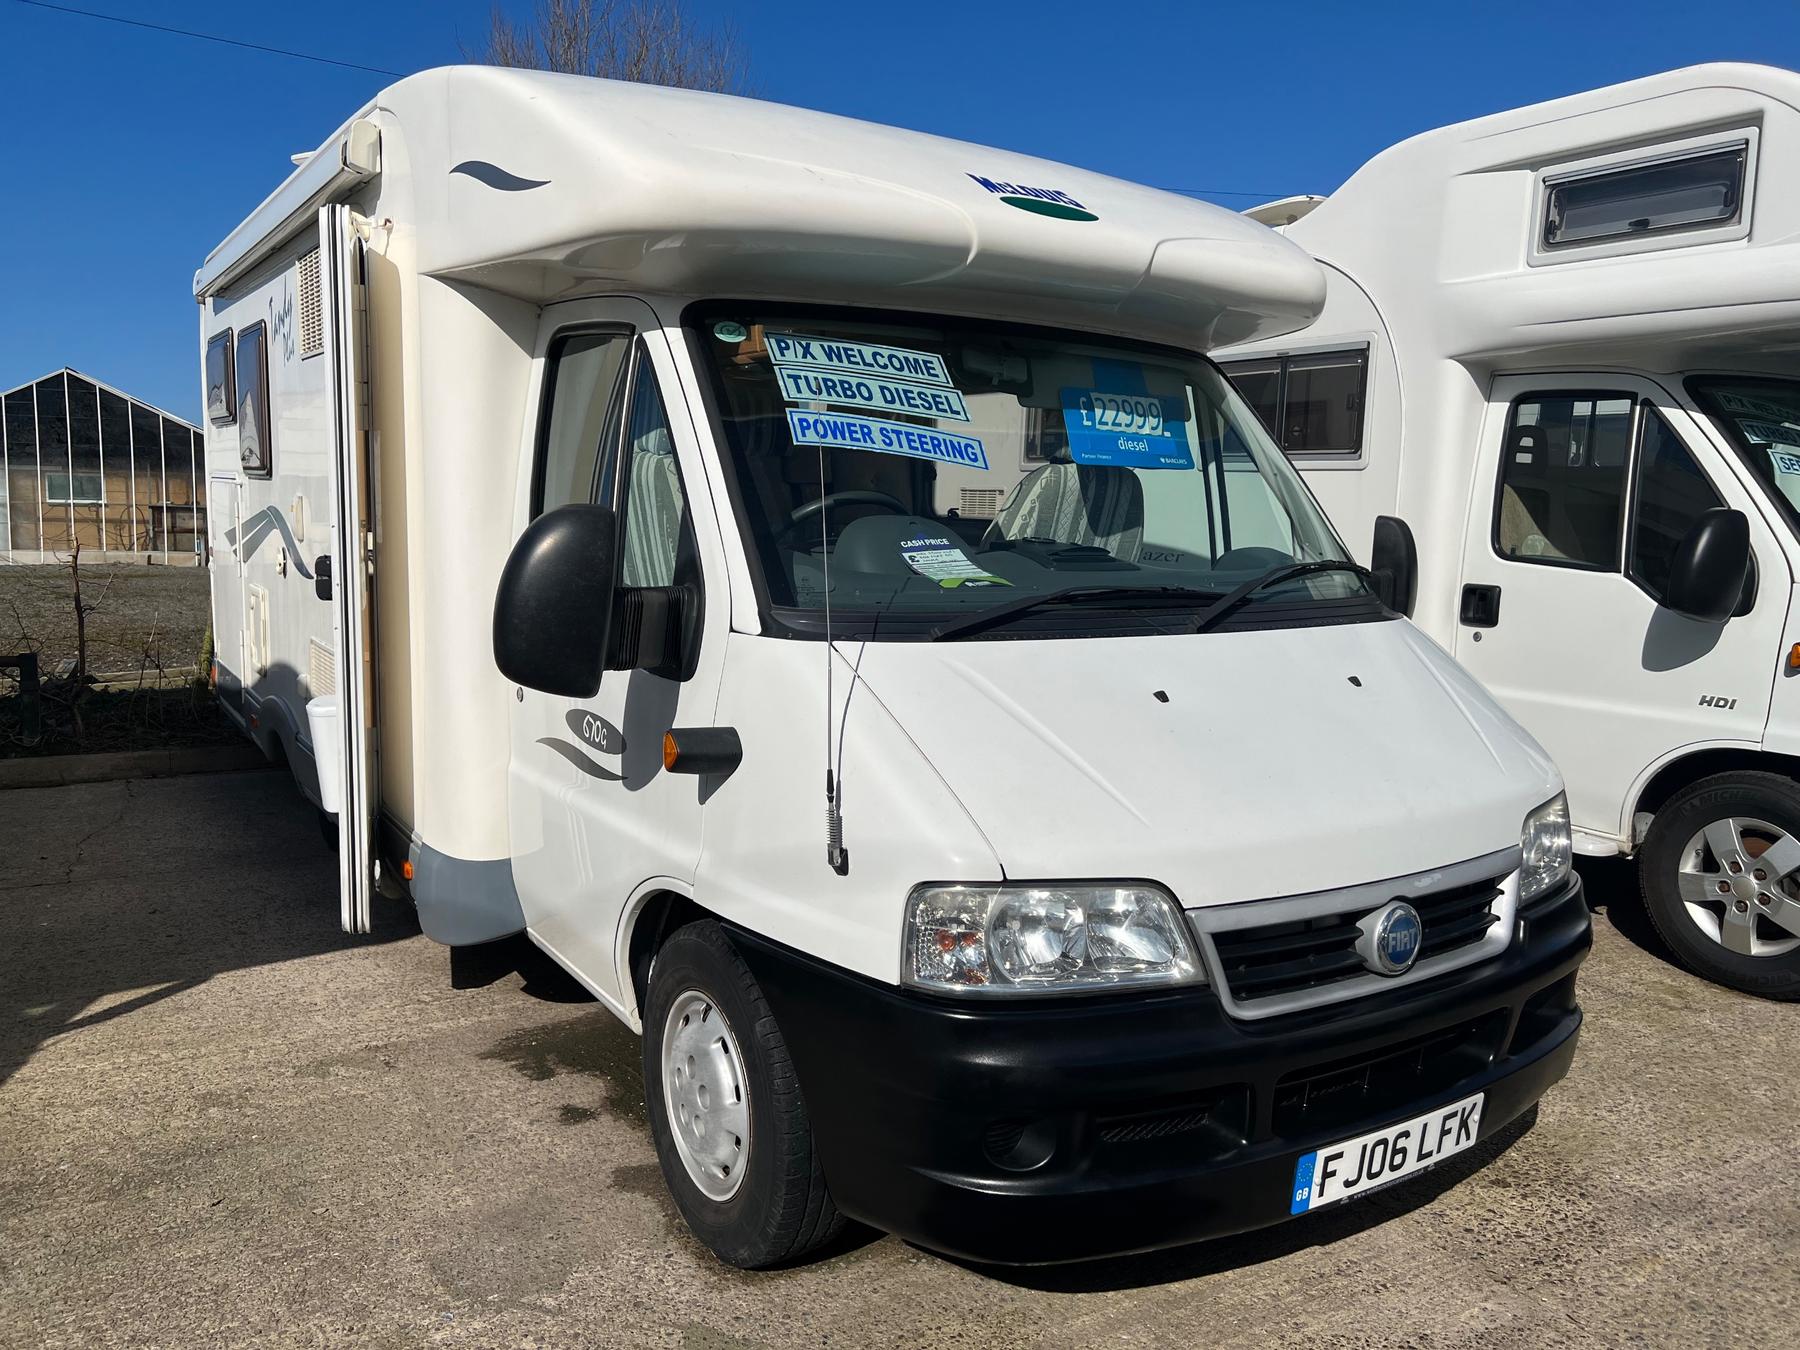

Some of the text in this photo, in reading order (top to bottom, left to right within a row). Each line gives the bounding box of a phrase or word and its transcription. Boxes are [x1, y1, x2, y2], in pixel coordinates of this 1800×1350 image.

[774, 338, 940, 378] P/X WELCOME
[787, 373, 961, 416] TURBO DIESEL
[797, 417, 979, 463] POWER STEERING
[1118, 436, 1149, 452] diesel
[900, 538, 950, 548] CASH PRICE
[1698, 694, 1738, 710] HDI
[1388, 927, 1417, 953] FIAT
[1317, 1129, 1411, 1199] FJ06
[1416, 1102, 1477, 1163] LFK
[1296, 1187, 1309, 1202] GB
